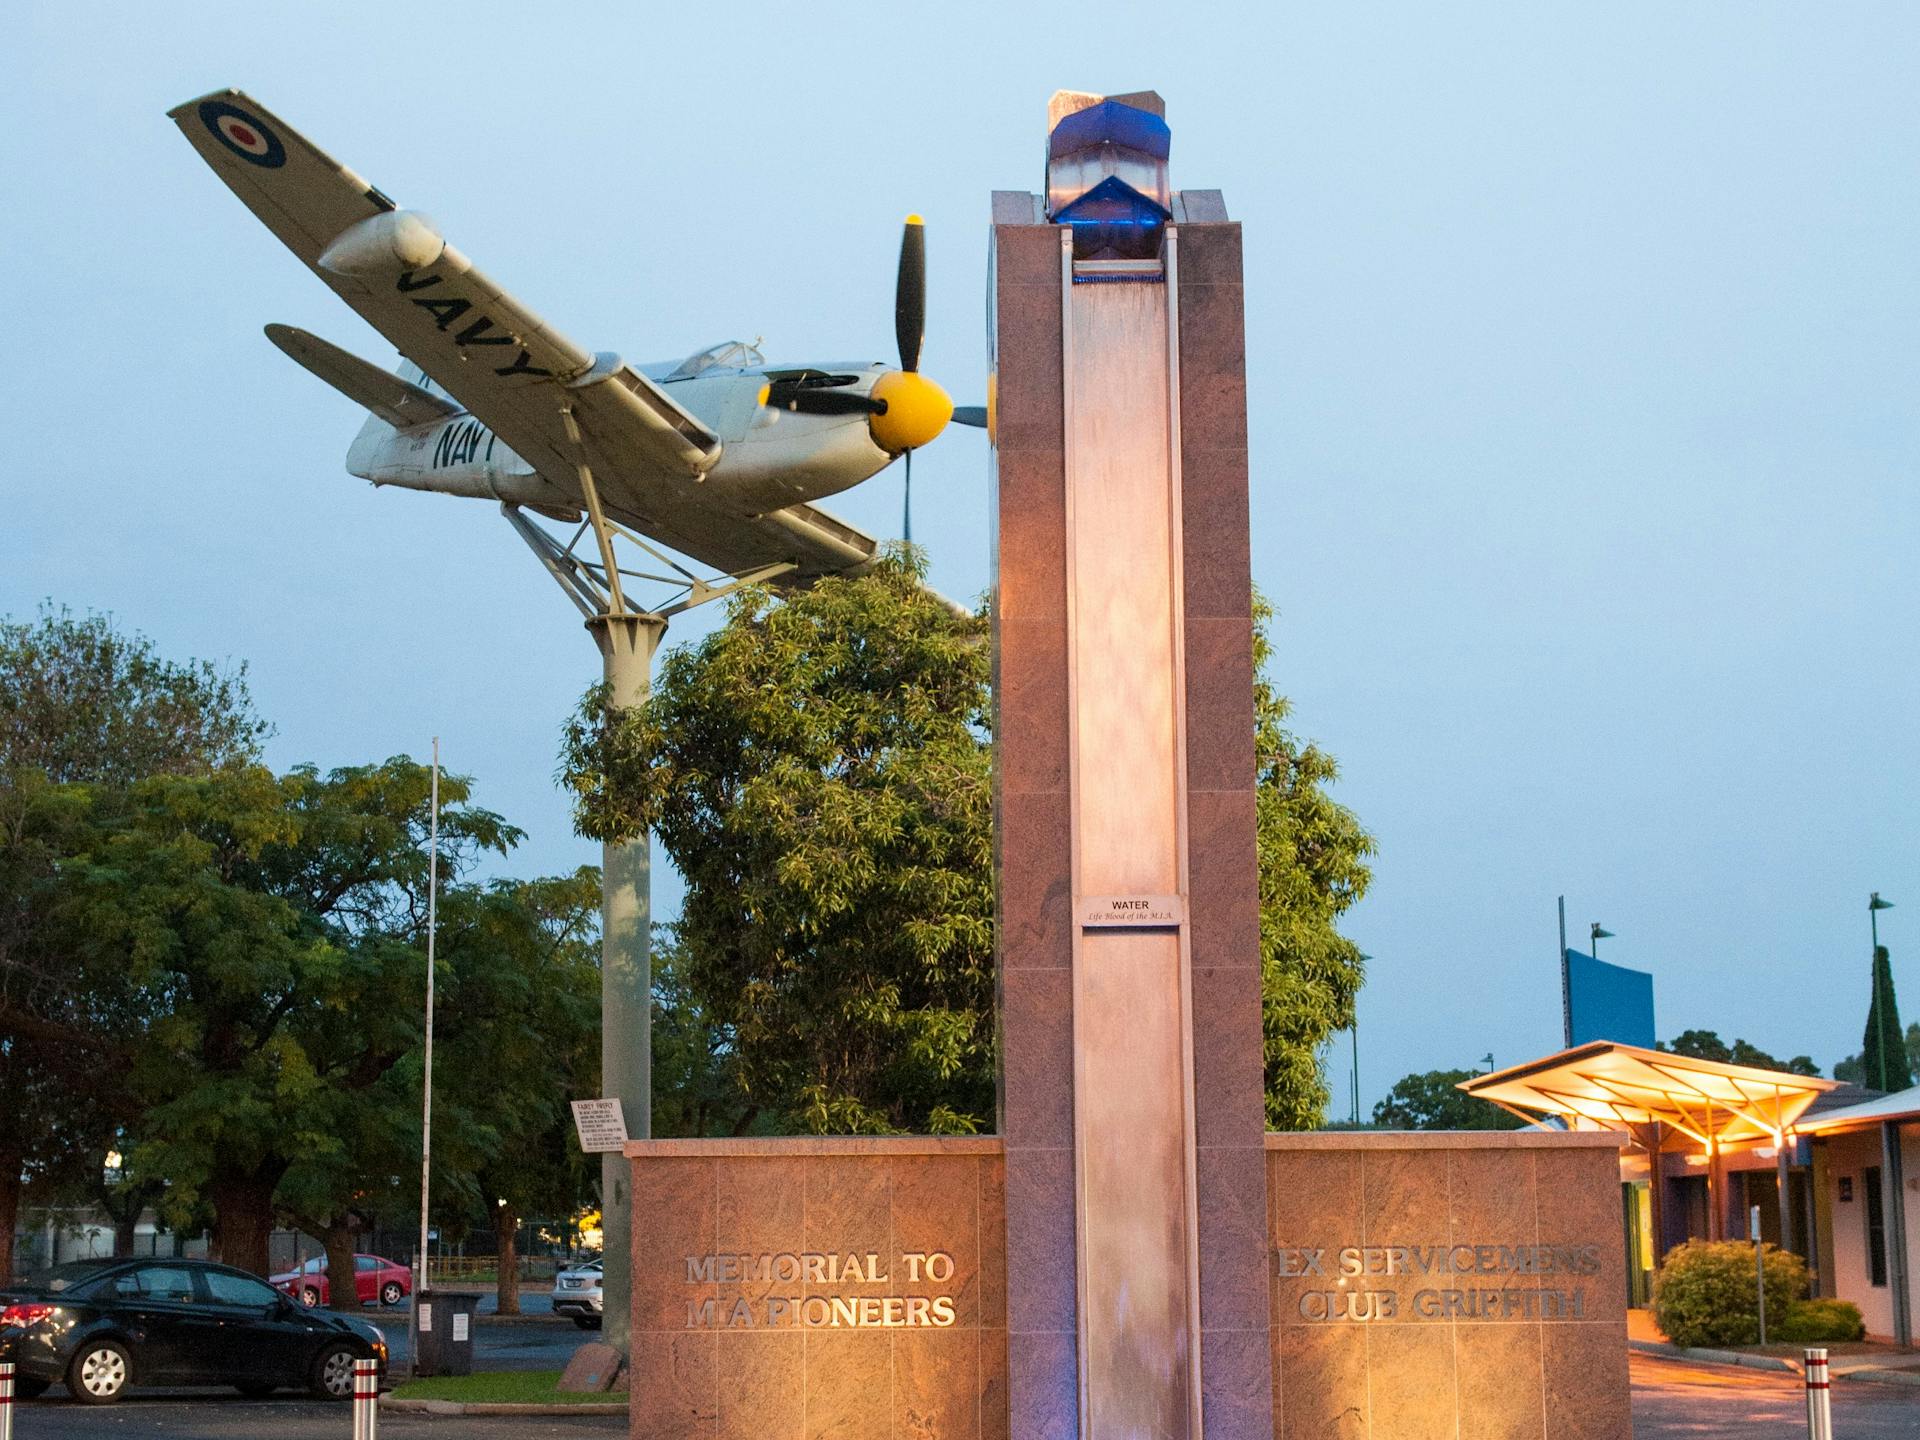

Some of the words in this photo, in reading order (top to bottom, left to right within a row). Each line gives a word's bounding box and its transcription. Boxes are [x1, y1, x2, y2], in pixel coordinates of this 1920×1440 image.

[1112, 901, 1149, 910] WATER
[1126, 912, 1134, 921] of
[1136, 912, 1148, 920] the
[685, 1252, 888, 1284] MEMORIAL
[902, 1252, 955, 1283] TO
[1277, 1248, 1326, 1278] EX
[1339, 1245, 1602, 1277] SERVICEMENS
[767, 1296, 956, 1328] PIONEERS
[1299, 1289, 1398, 1322] CLUB
[1413, 1286, 1585, 1320] GRIFFITH
